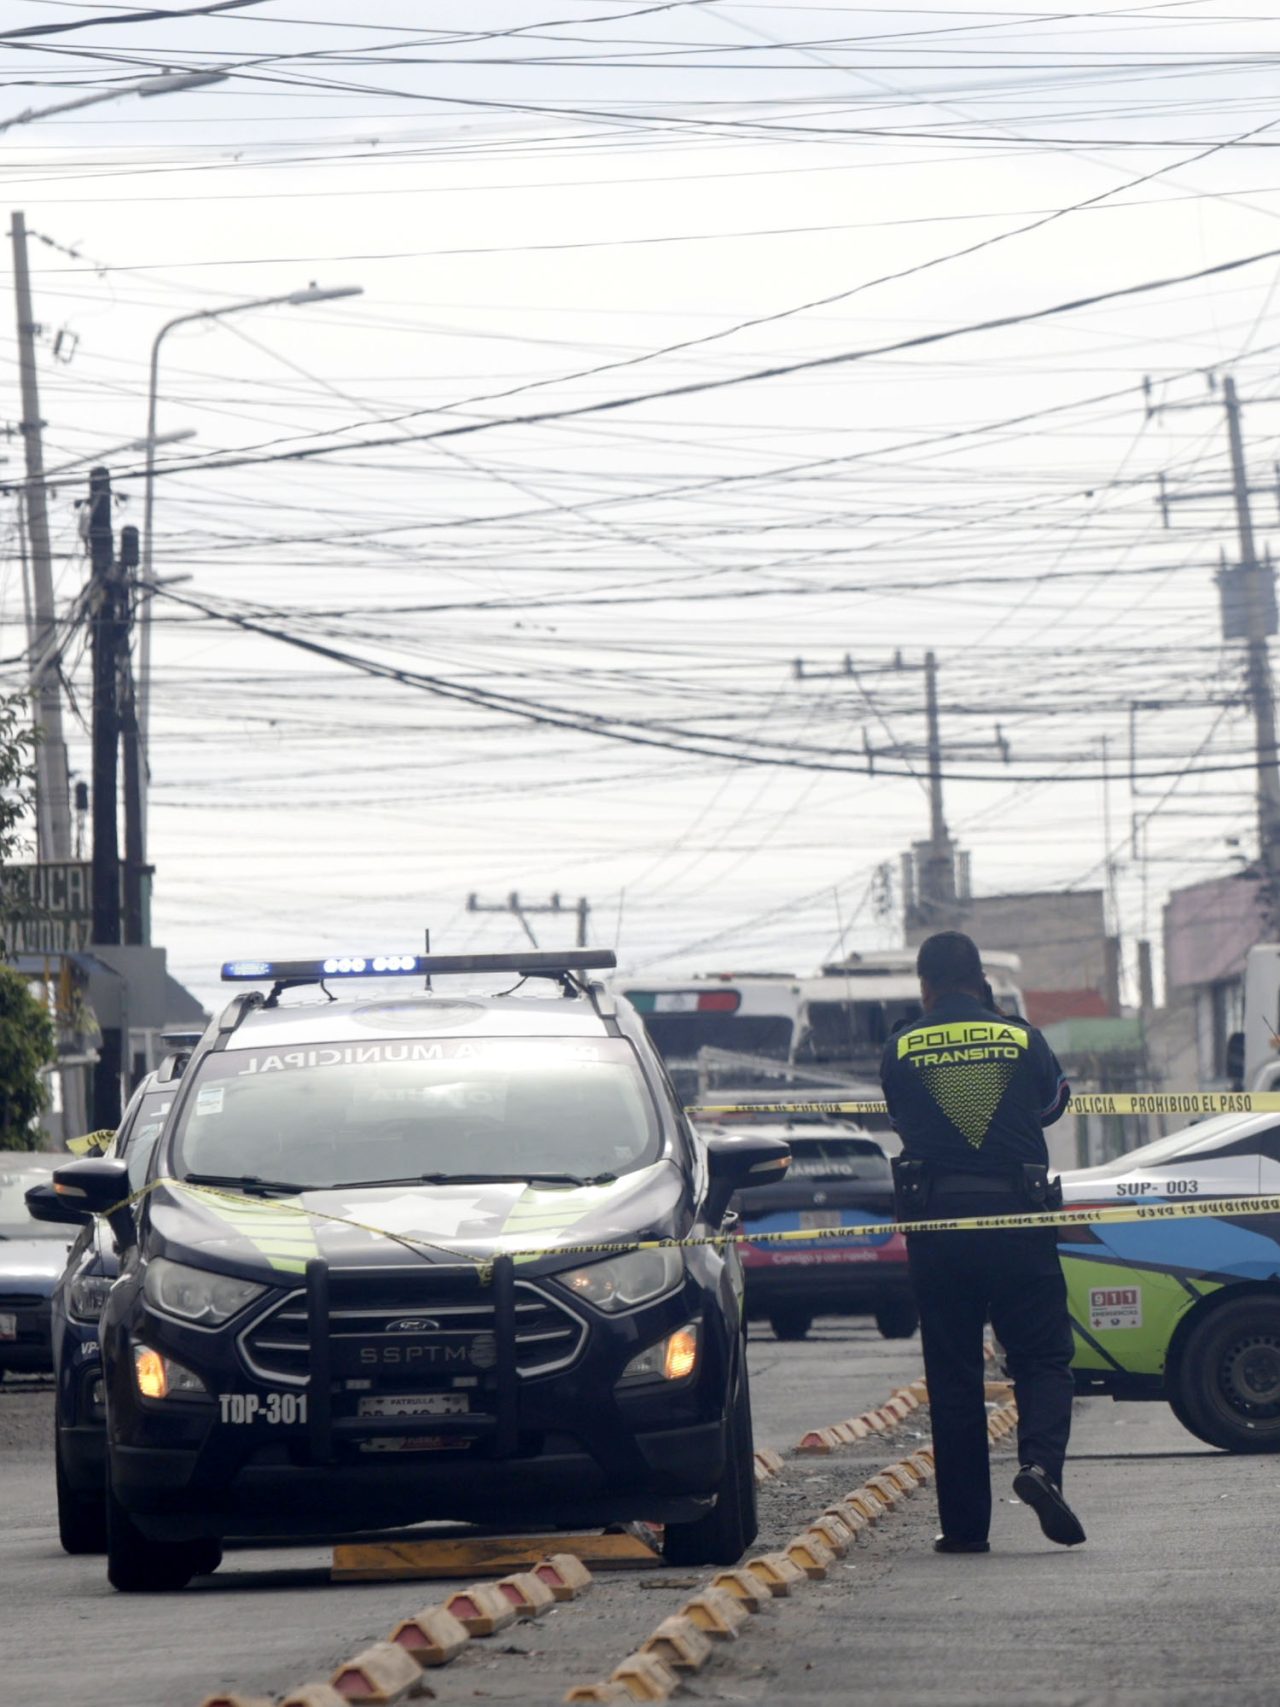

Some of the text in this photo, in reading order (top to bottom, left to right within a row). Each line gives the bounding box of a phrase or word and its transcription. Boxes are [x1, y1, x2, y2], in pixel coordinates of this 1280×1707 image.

[908, 1026, 1015, 1049] POLICIA
[910, 1047, 1019, 1068] TRANSITO
[1067, 1097, 1115, 1113] POLICIA
[1131, 1096, 1198, 1113] PROHIBIDO
[1203, 1095, 1217, 1112] EL
[1220, 1094, 1251, 1112] PASO
[1116, 1180, 1198, 1196] SUP- 003
[1092, 1290, 1136, 1306] 911
[360, 1345, 467, 1364] SSPTM
[219, 1394, 307, 1424] TDP-301
